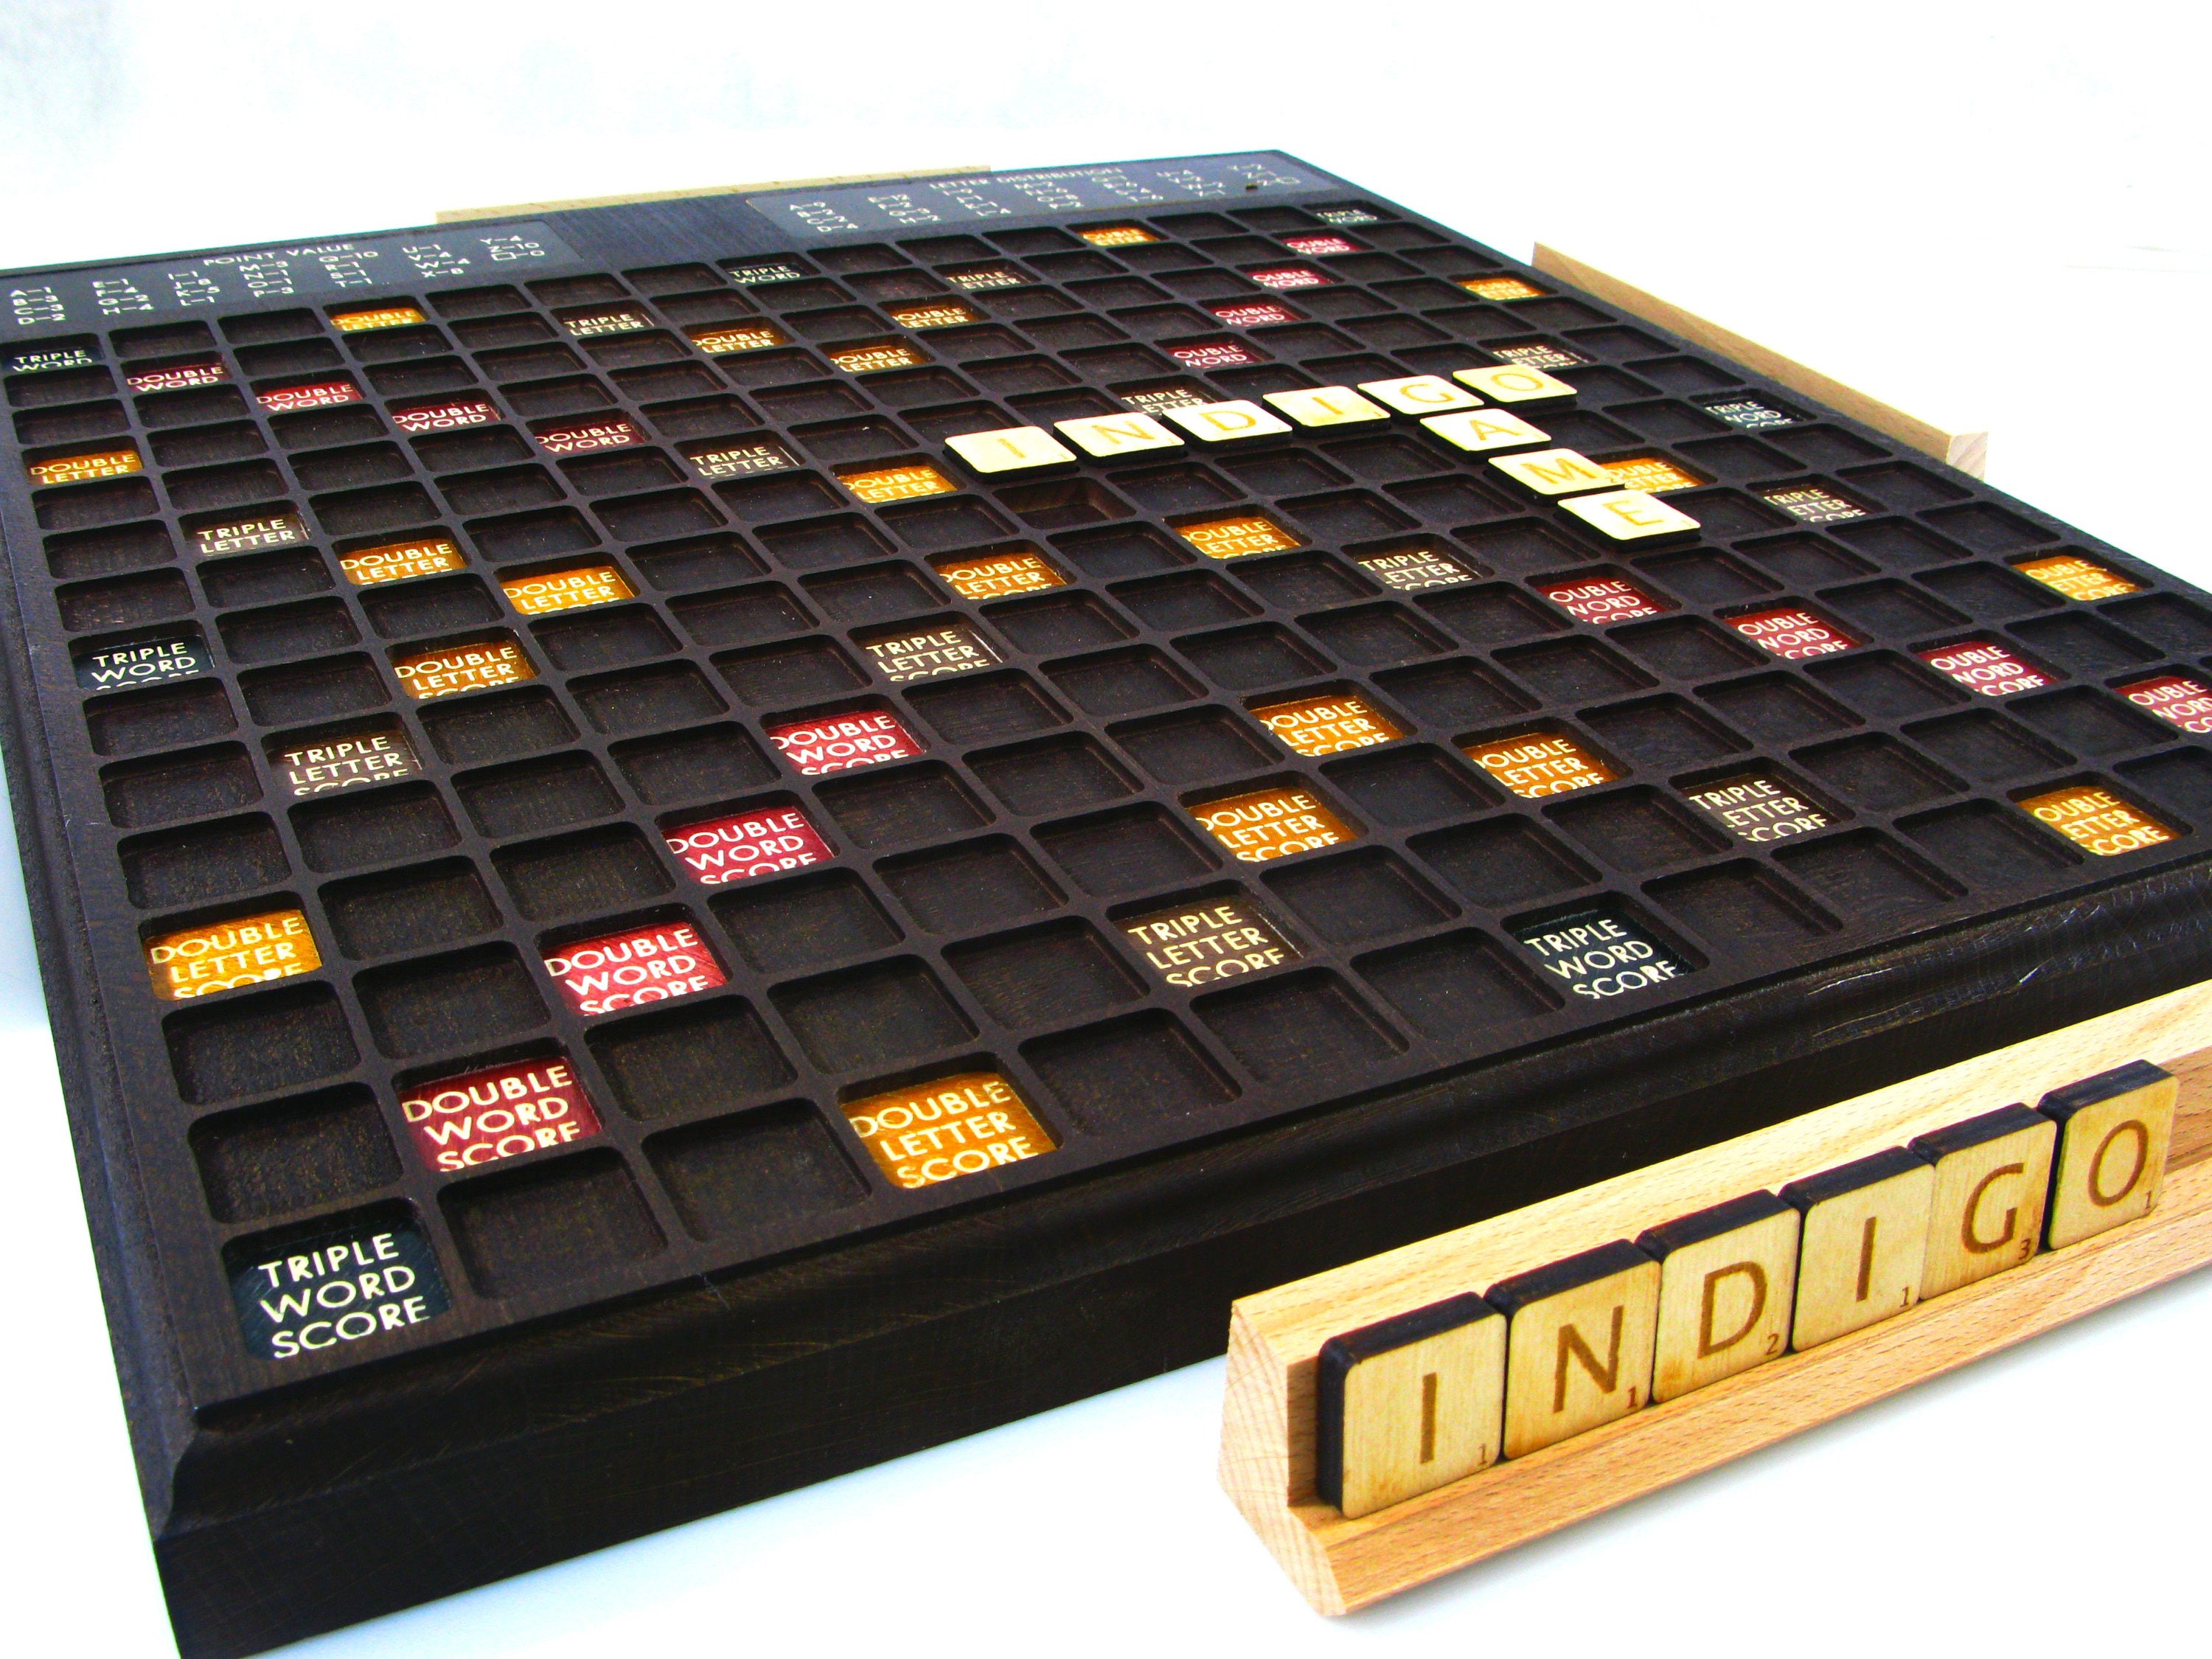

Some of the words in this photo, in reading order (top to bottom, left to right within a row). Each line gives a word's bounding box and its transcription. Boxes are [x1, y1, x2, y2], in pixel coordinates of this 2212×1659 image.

[204, 251, 275, 266] POINT
[286, 243, 354, 257] VALUE
[729, 265, 789, 278] TRIPLE
[734, 271, 799, 284] WORD
[947, 271, 1006, 285] TRIPLE
[331, 310, 415, 325] DOUBLE
[564, 313, 634, 328] TRIPLE
[1215, 305, 1276, 319] OUBLE
[570, 321, 644, 336] LETTER
[15, 349, 86, 364] TRIPLE
[1174, 344, 1243, 359] OUBLE
[1492, 345, 1553, 361] TRIPLE
[127, 367, 224, 386] DOUBLE
[136, 375, 219, 392] WORD
[257, 384, 354, 404] DOUBLE
[268, 394, 349, 412] WORD
[1121, 389, 1194, 407] TRIPLE
[393, 403, 490, 425] DOUBLE
[402, 414, 487, 432] WORD
[546, 434, 631, 453] WORD
[690, 445, 771, 466] TRIPLE
[30, 453, 136, 475] DOUBLE
[42, 464, 130, 484] LETTER
[698, 456, 783, 477] LETTER
[857, 480, 939, 501] LETTER
[1764, 487, 1829, 506] TRIPLE
[198, 518, 288, 542] TRIPLE
[200, 530, 296, 554] LETTER
[339, 543, 453, 571] DOUBLE
[355, 557, 450, 581] LETTER
[1358, 550, 1440, 573] TRIPLE
[503, 571, 616, 599] DOUBLE
[954, 571, 1046, 596] LETTER
[1549, 580, 1632, 604] OUBLE
[521, 585, 615, 611] LETTER
[1738, 612, 1819, 636] OUBLE
[92, 641, 187, 668] TRIPLE
[866, 630, 962, 658] TRIPLE
[91, 656, 198, 684] WORD
[394, 647, 518, 680] DOUBLE
[877, 645, 980, 675] LETTER
[1930, 645, 2011, 671] OUBLE
[412, 663, 515, 691] LETTER
[2129, 681, 2208, 706] OUBLE
[1278, 717, 1377, 747] LETTER
[284, 736, 392, 767] TRIPLE
[786, 734, 897, 765] WORD
[288, 752, 403, 785] LETTER
[1689, 780, 1781, 810] TRIPLE
[2034, 791, 2121, 823] OUBLE
[665, 813, 805, 855] DOUBLE
[1217, 814, 1326, 850] LETTER
[684, 835, 804, 872] WORD
[1127, 906, 1243, 945] TRIPLE
[1523, 919, 1627, 957] TRIPLE
[150, 917, 304, 964] DOUBLE
[543, 928, 698, 978] DOUBLE
[1146, 927, 1269, 970] LETTER
[170, 942, 298, 984] LETTER
[1543, 940, 1654, 979] WORD
[565, 955, 697, 996] WORD
[1572, 960, 1677, 1000] SCORE
[402, 1065, 573, 1123] DOUBLE
[423, 1096, 569, 1146] WORD
[848, 1080, 1012, 1138] DOUBLE
[437, 1121, 580, 1172] SCORE
[879, 1110, 1017, 1162] LETTER
[896, 1135, 1039, 1190] SCORE
[2144, 1189, 2154, 1211] 1
[257, 1233, 400, 1288] TRIPLE
[2018, 1238, 2032, 1260] 3
[260, 1265, 416, 1324] WORD
[1899, 1285, 1910, 1309] 1
[271, 1295, 431, 1358] SCORE
[1765, 1332, 1781, 1357] 2
[1626, 1386, 1638, 1410] 1
[1477, 1444, 1489, 1467] 1
